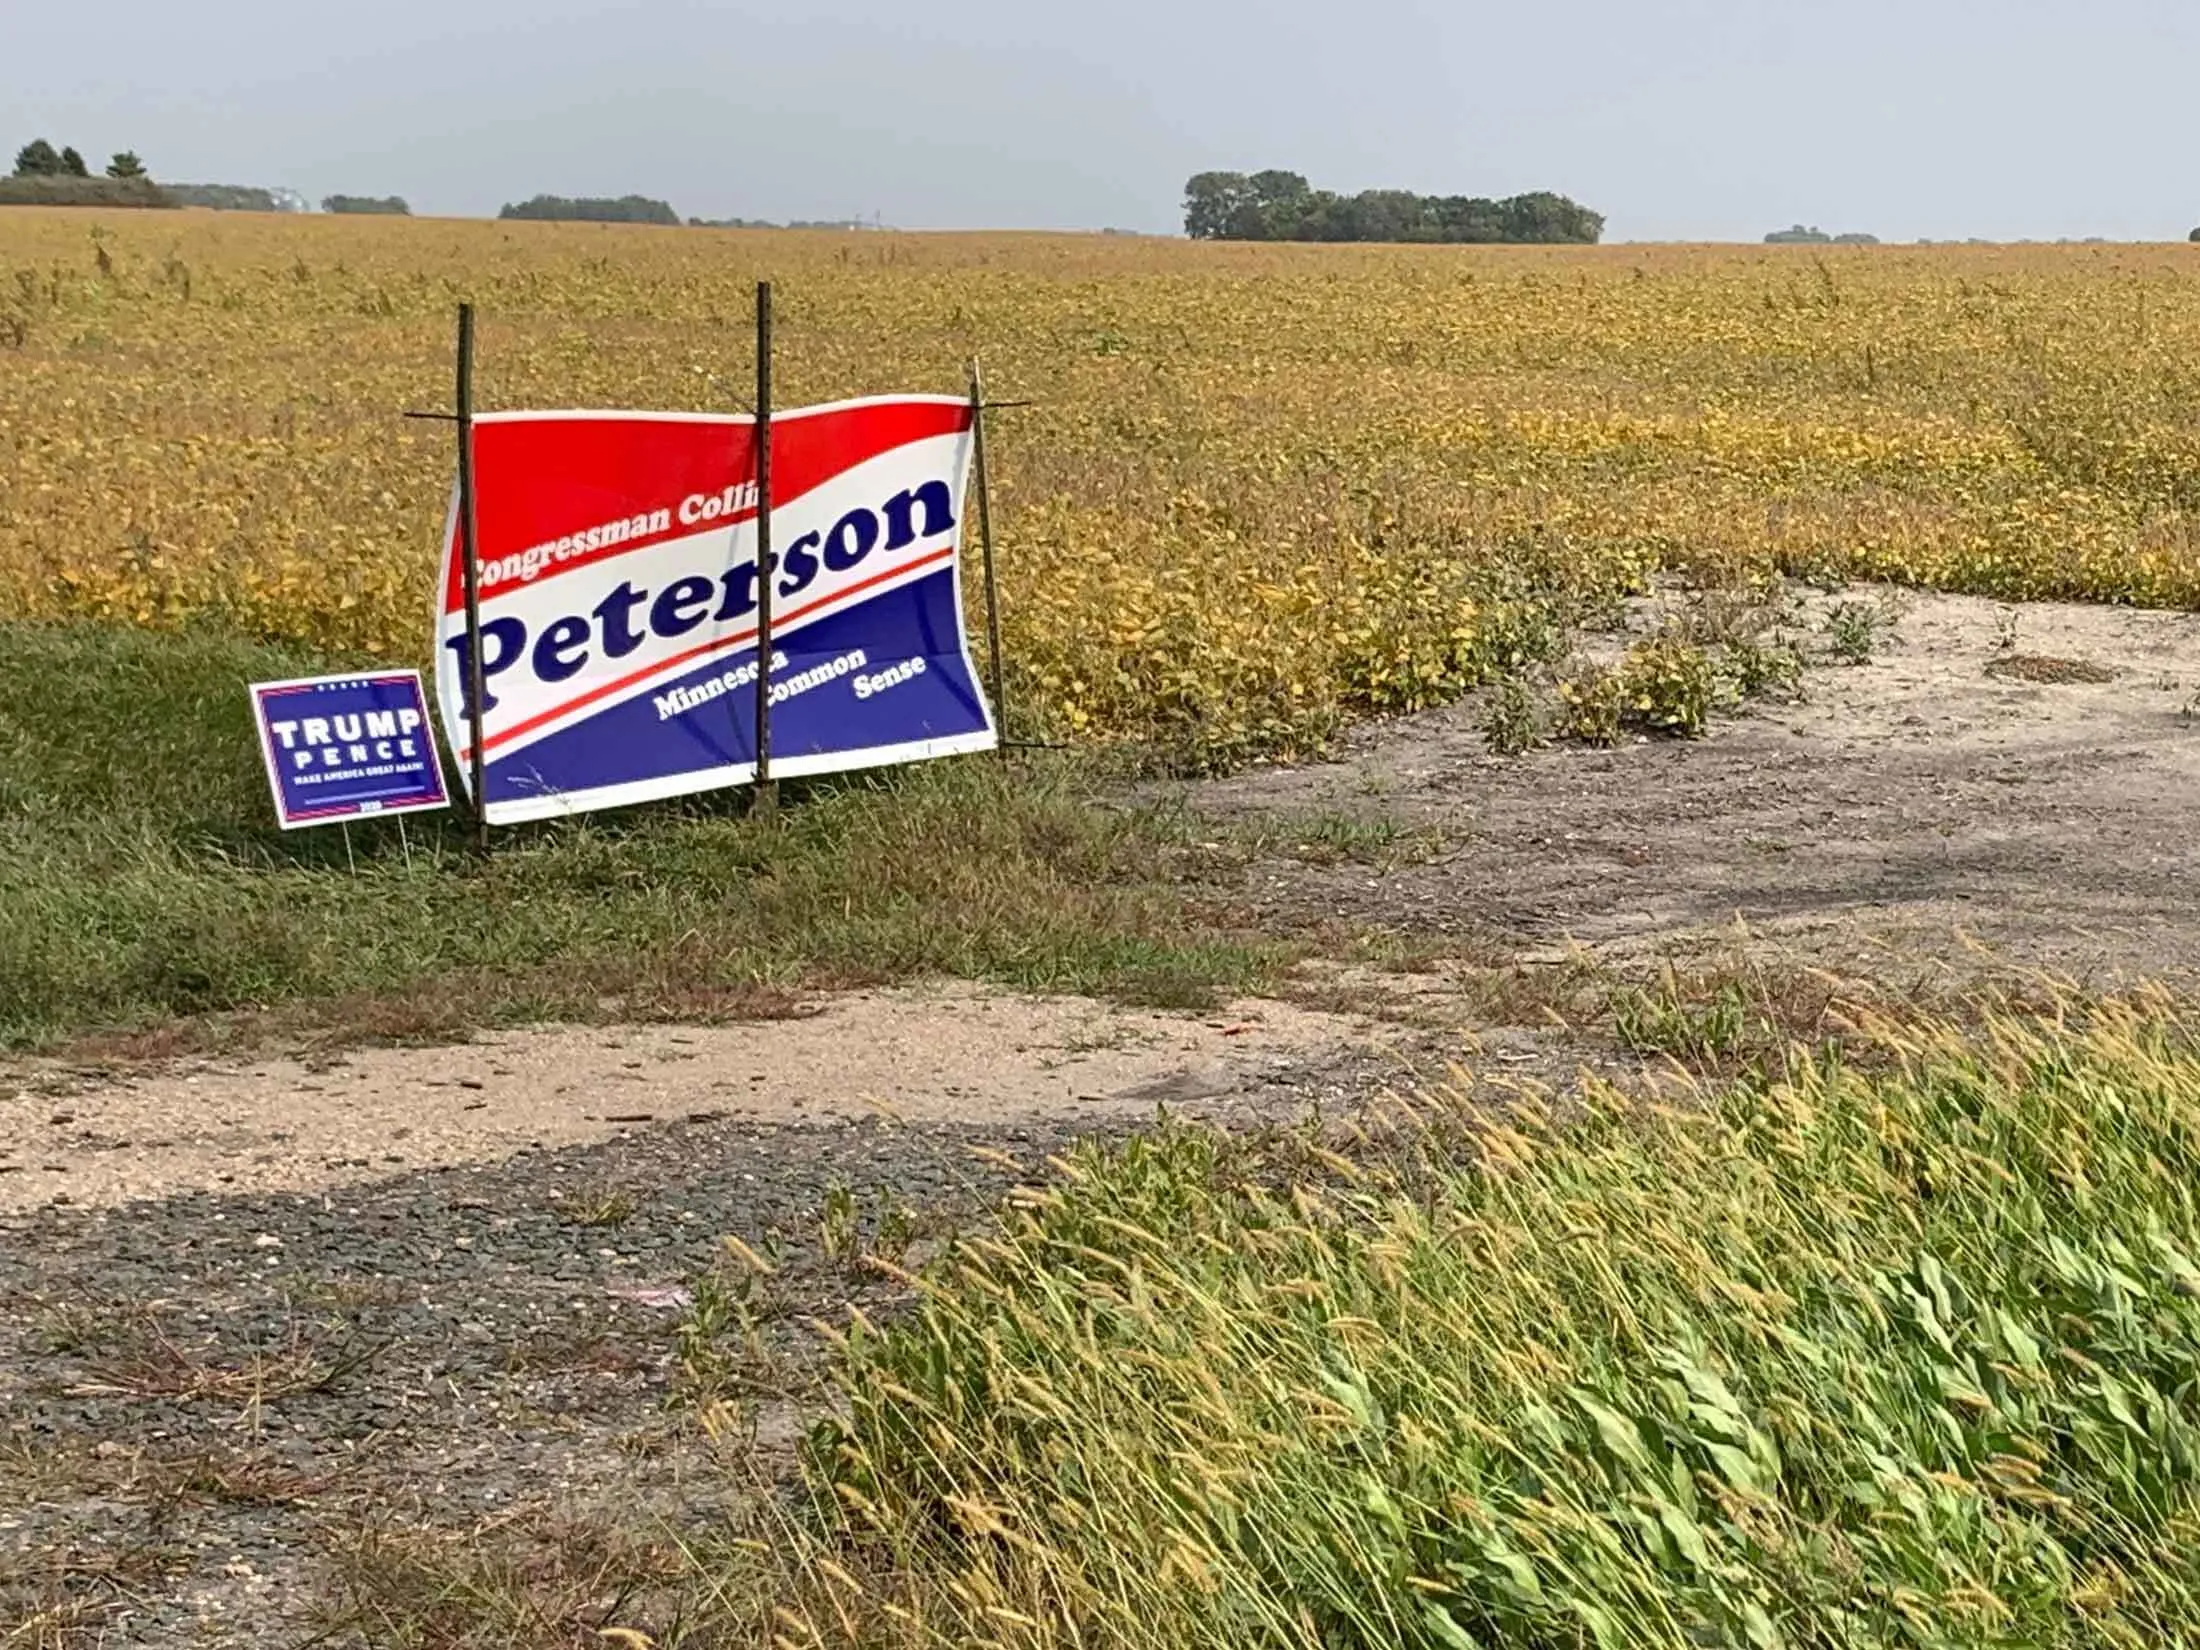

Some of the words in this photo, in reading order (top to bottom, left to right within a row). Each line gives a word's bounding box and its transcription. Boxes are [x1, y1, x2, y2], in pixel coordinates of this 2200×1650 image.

[679, 479, 759, 525] Colli
[445, 478, 957, 720] Peterson
[653, 649, 789, 721] Minnesoa
[852, 655, 926, 699] Sense
[272, 709, 420, 748] TRUMP
[294, 739, 417, 770] PENCE
[294, 774, 322, 785] MAKE
[324, 769, 365, 781] AMERICA
[366, 765, 394, 776] GREAT
